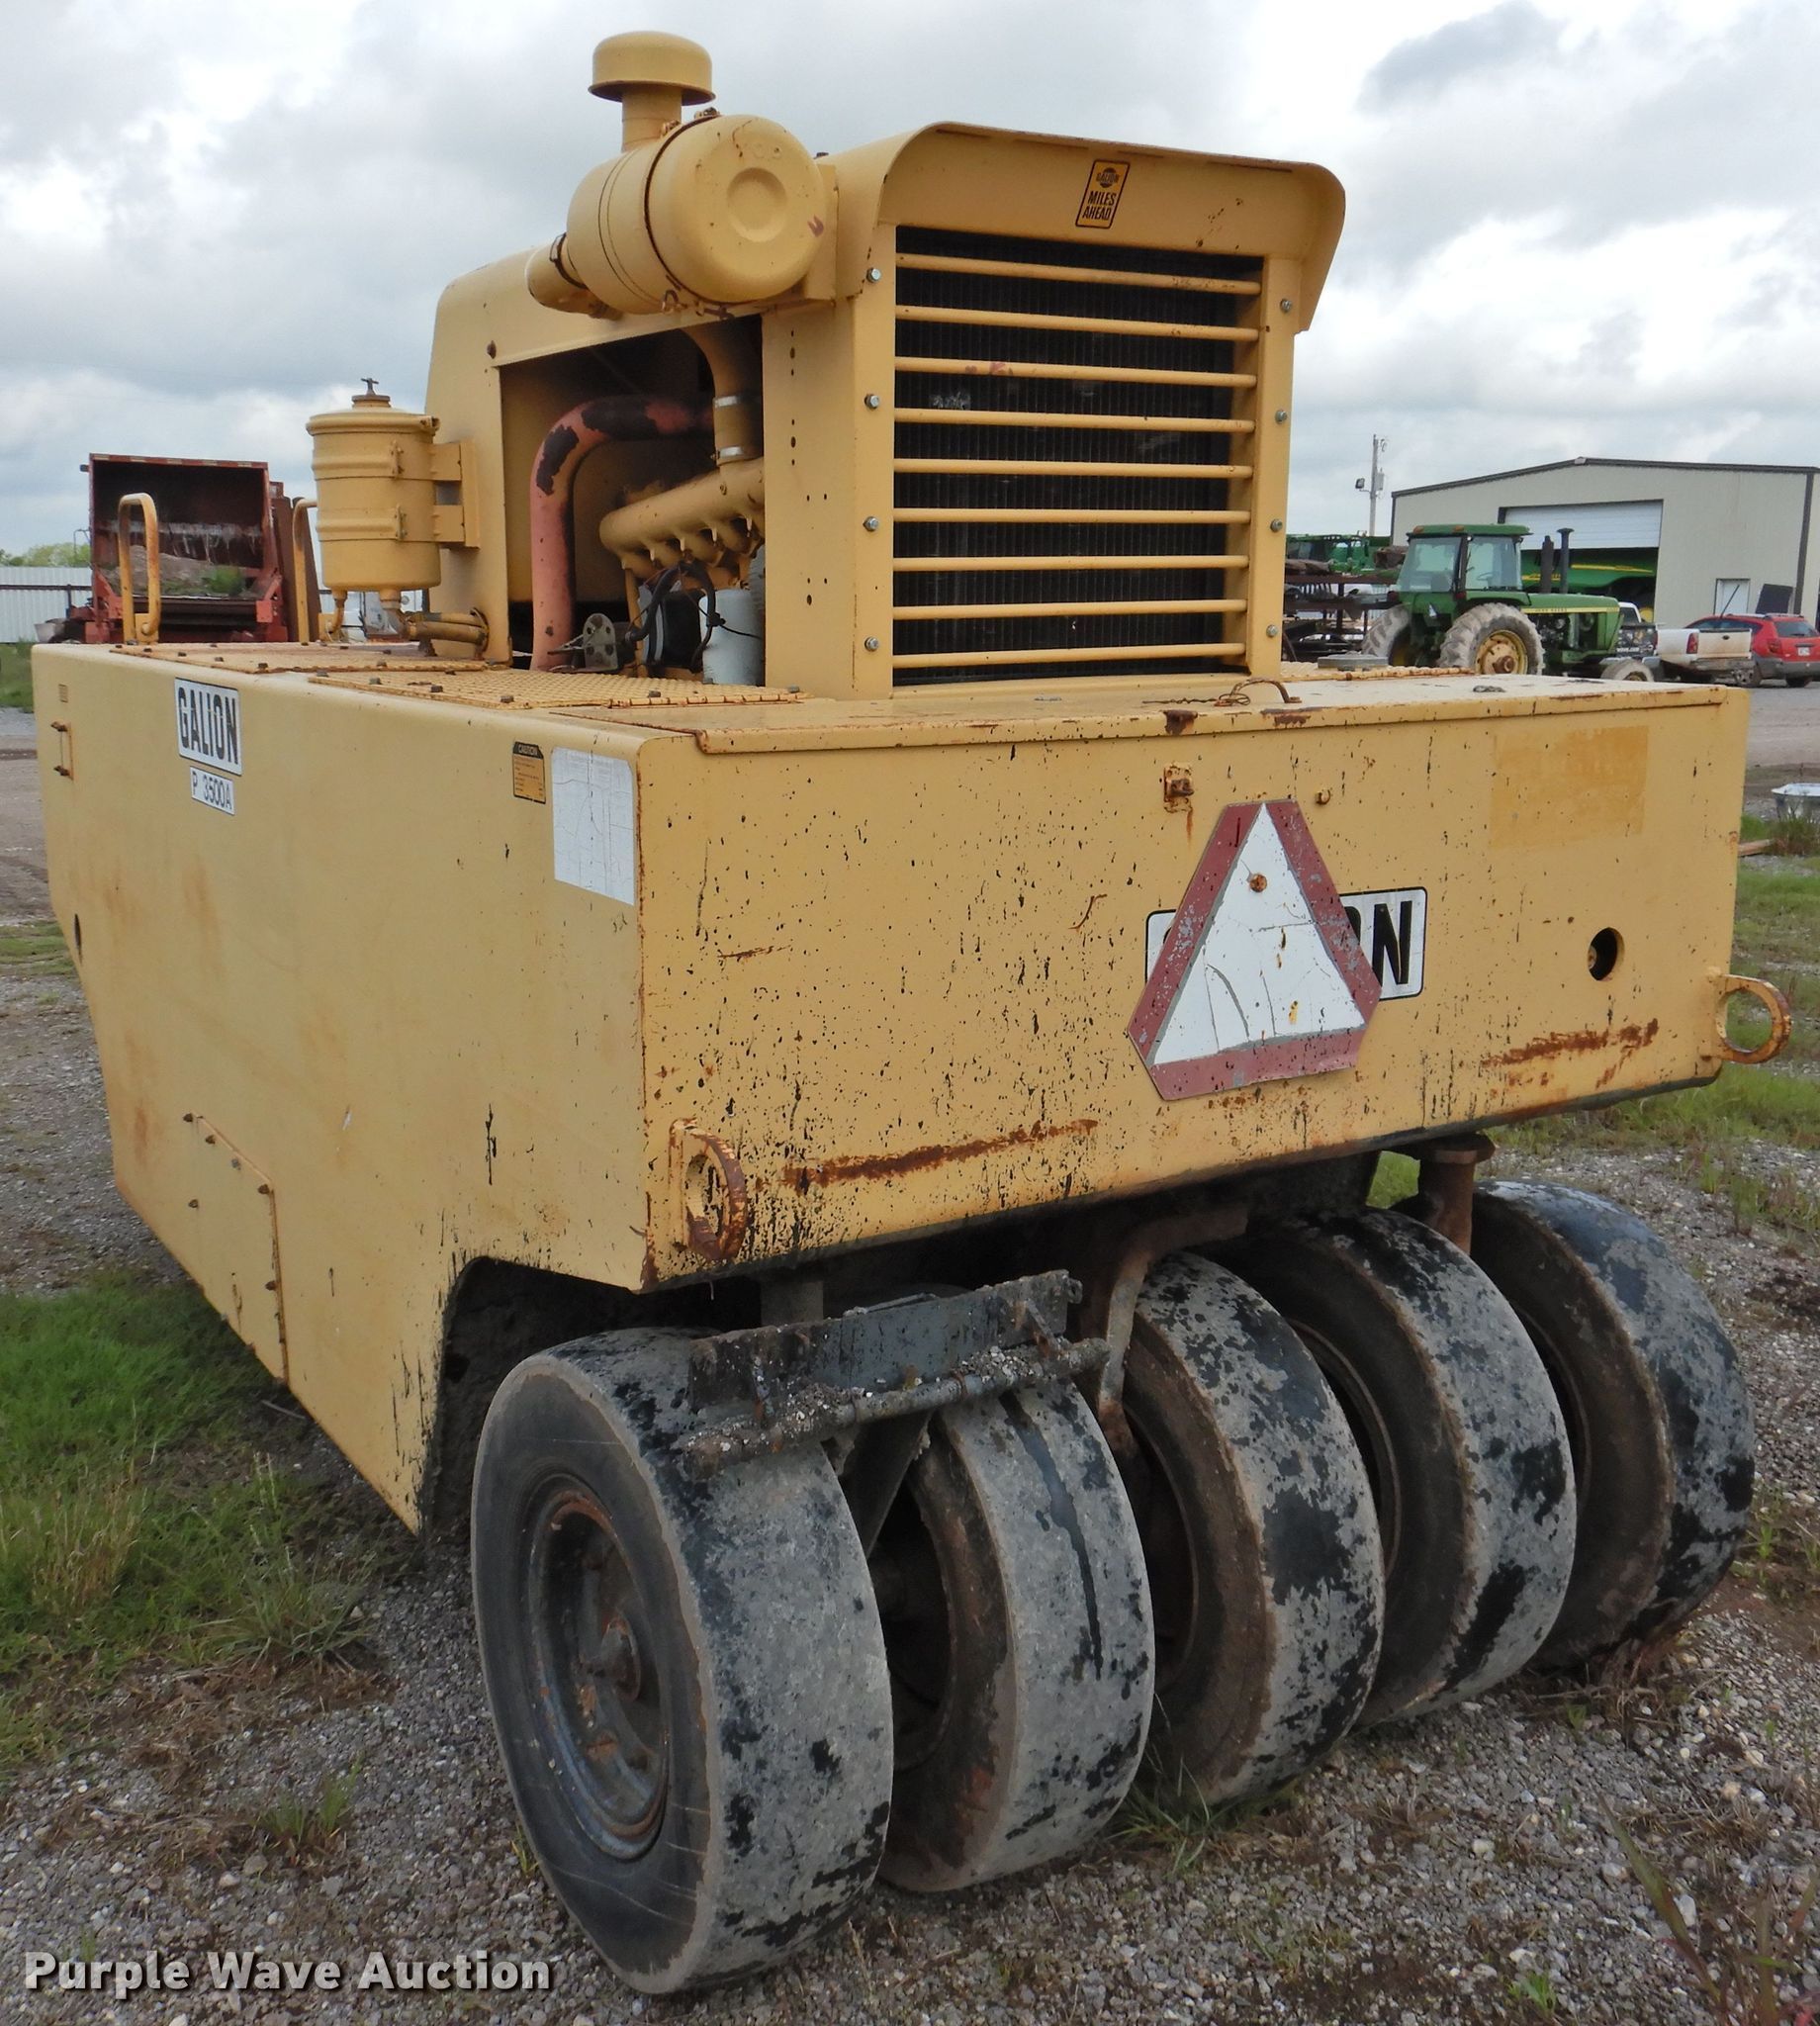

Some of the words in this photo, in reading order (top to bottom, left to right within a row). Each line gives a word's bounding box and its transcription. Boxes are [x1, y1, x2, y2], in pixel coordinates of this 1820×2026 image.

[1088, 191, 1117, 206] MILES
[1082, 206, 1112, 221] AHEAD
[178, 687, 238, 765] GALION
[192, 771, 198, 795] P
[202, 775, 232, 809] 3500A
